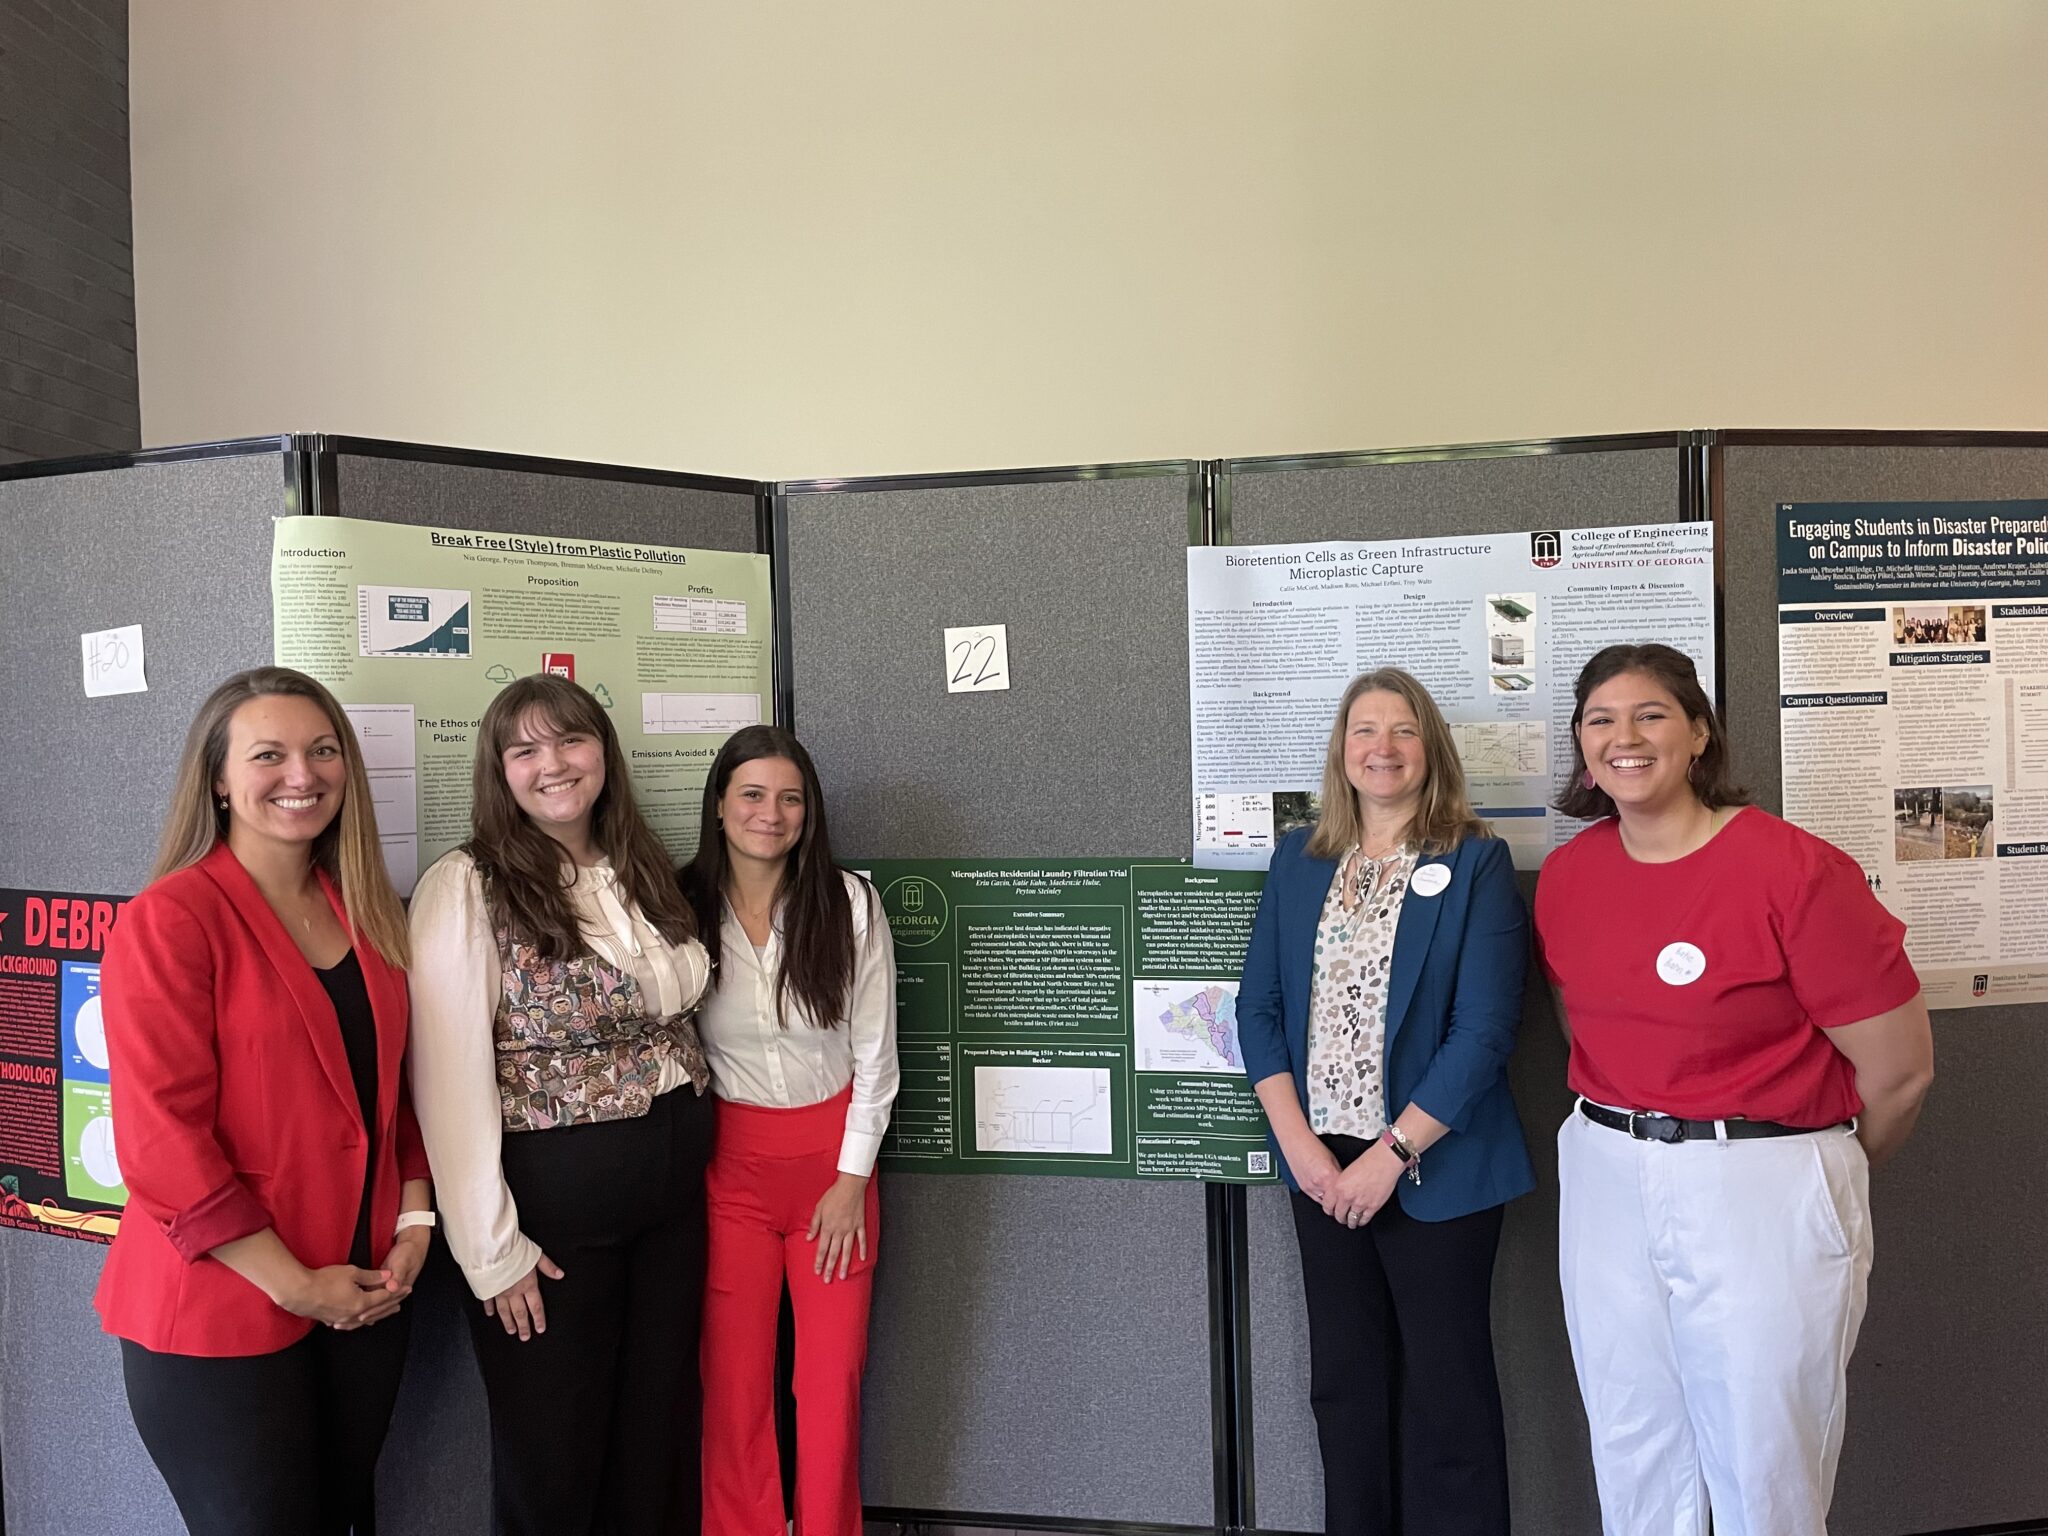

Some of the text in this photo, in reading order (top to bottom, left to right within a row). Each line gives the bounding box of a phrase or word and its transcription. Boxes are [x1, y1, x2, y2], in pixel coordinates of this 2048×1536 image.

[1789, 515, 2048, 540] Engaging Students in Disaster Prepared
[1571, 526, 1708, 542] College of Engineering
[280, 547, 346, 558] Introduction
[431, 532, 686, 563] Break Free (Style) from Plastic Pollution
[1809, 545, 1826, 559] on
[1829, 540, 1883, 562] Campus
[1887, 540, 1900, 558] to
[1905, 539, 1948, 557] Inform
[1952, 538, 2013, 556] Disaster
[1226, 544, 1492, 567] Bioretention Cells as Green Infrastructure
[1571, 557, 1704, 570] UNIVERSITY OF GEORGIA
[1289, 562, 1424, 581] Microplastic Capture
[527, 575, 579, 587] Proposition
[687, 584, 714, 594] Profits
[1567, 585, 1609, 593] Community
[1403, 593, 1426, 601] Design
[1814, 611, 1854, 620] Overview
[2000, 605, 2048, 616] Stakeholder
[952, 636, 1000, 686] 22
[1896, 652, 1984, 665] Mitigation Strategies
[1252, 690, 1291, 698] Background
[1785, 693, 1884, 706] Campus Questionnaire
[417, 718, 481, 728] The Ethos of
[433, 733, 467, 743] Plastic
[631, 749, 716, 758] Emissions Avoided &
[2006, 845, 2038, 855] Student
[951, 869, 1127, 879] Microplastics Residential Laundry Filtration Trial
[887, 915, 940, 925] GEORGIA
[892, 928, 936, 937] Engineering
[0, 955, 57, 977] CKGROUND
[0, 1061, 57, 1086] HODOLOGY
